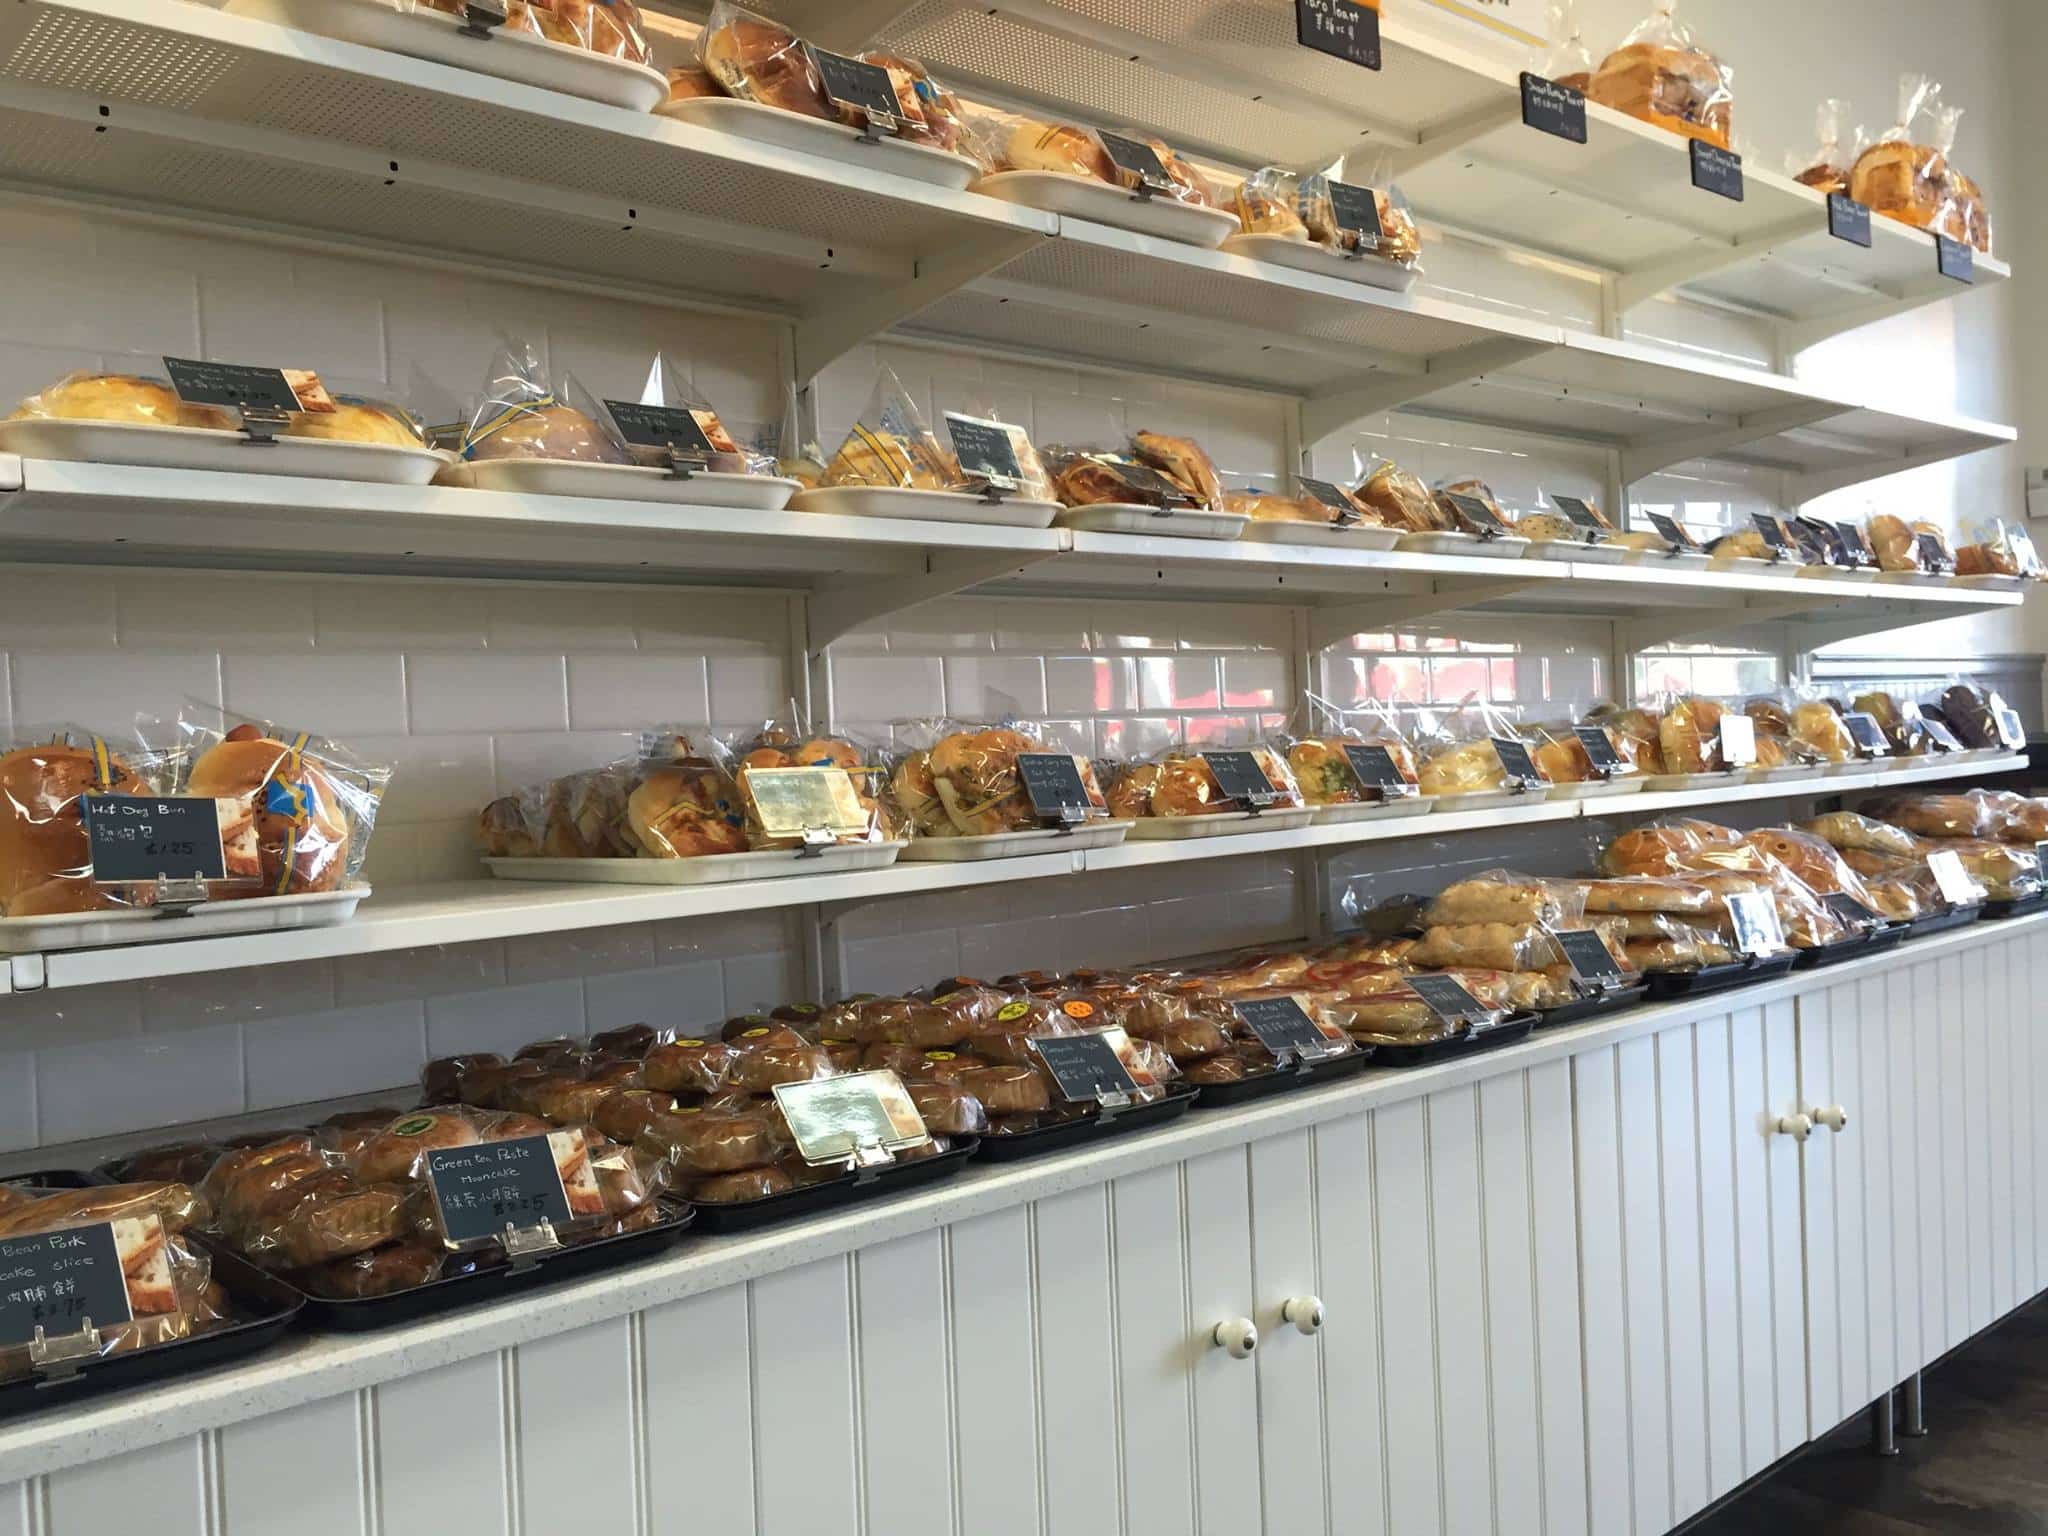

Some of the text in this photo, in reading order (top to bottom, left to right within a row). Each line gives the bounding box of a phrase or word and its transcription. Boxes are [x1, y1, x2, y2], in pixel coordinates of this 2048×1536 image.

[91, 803, 186, 817] Hot Dog Bun
[432, 1155, 473, 1172] Green
[496, 1146, 530, 1162] Paste
[1, 1233, 87, 1258] Bean Pork
